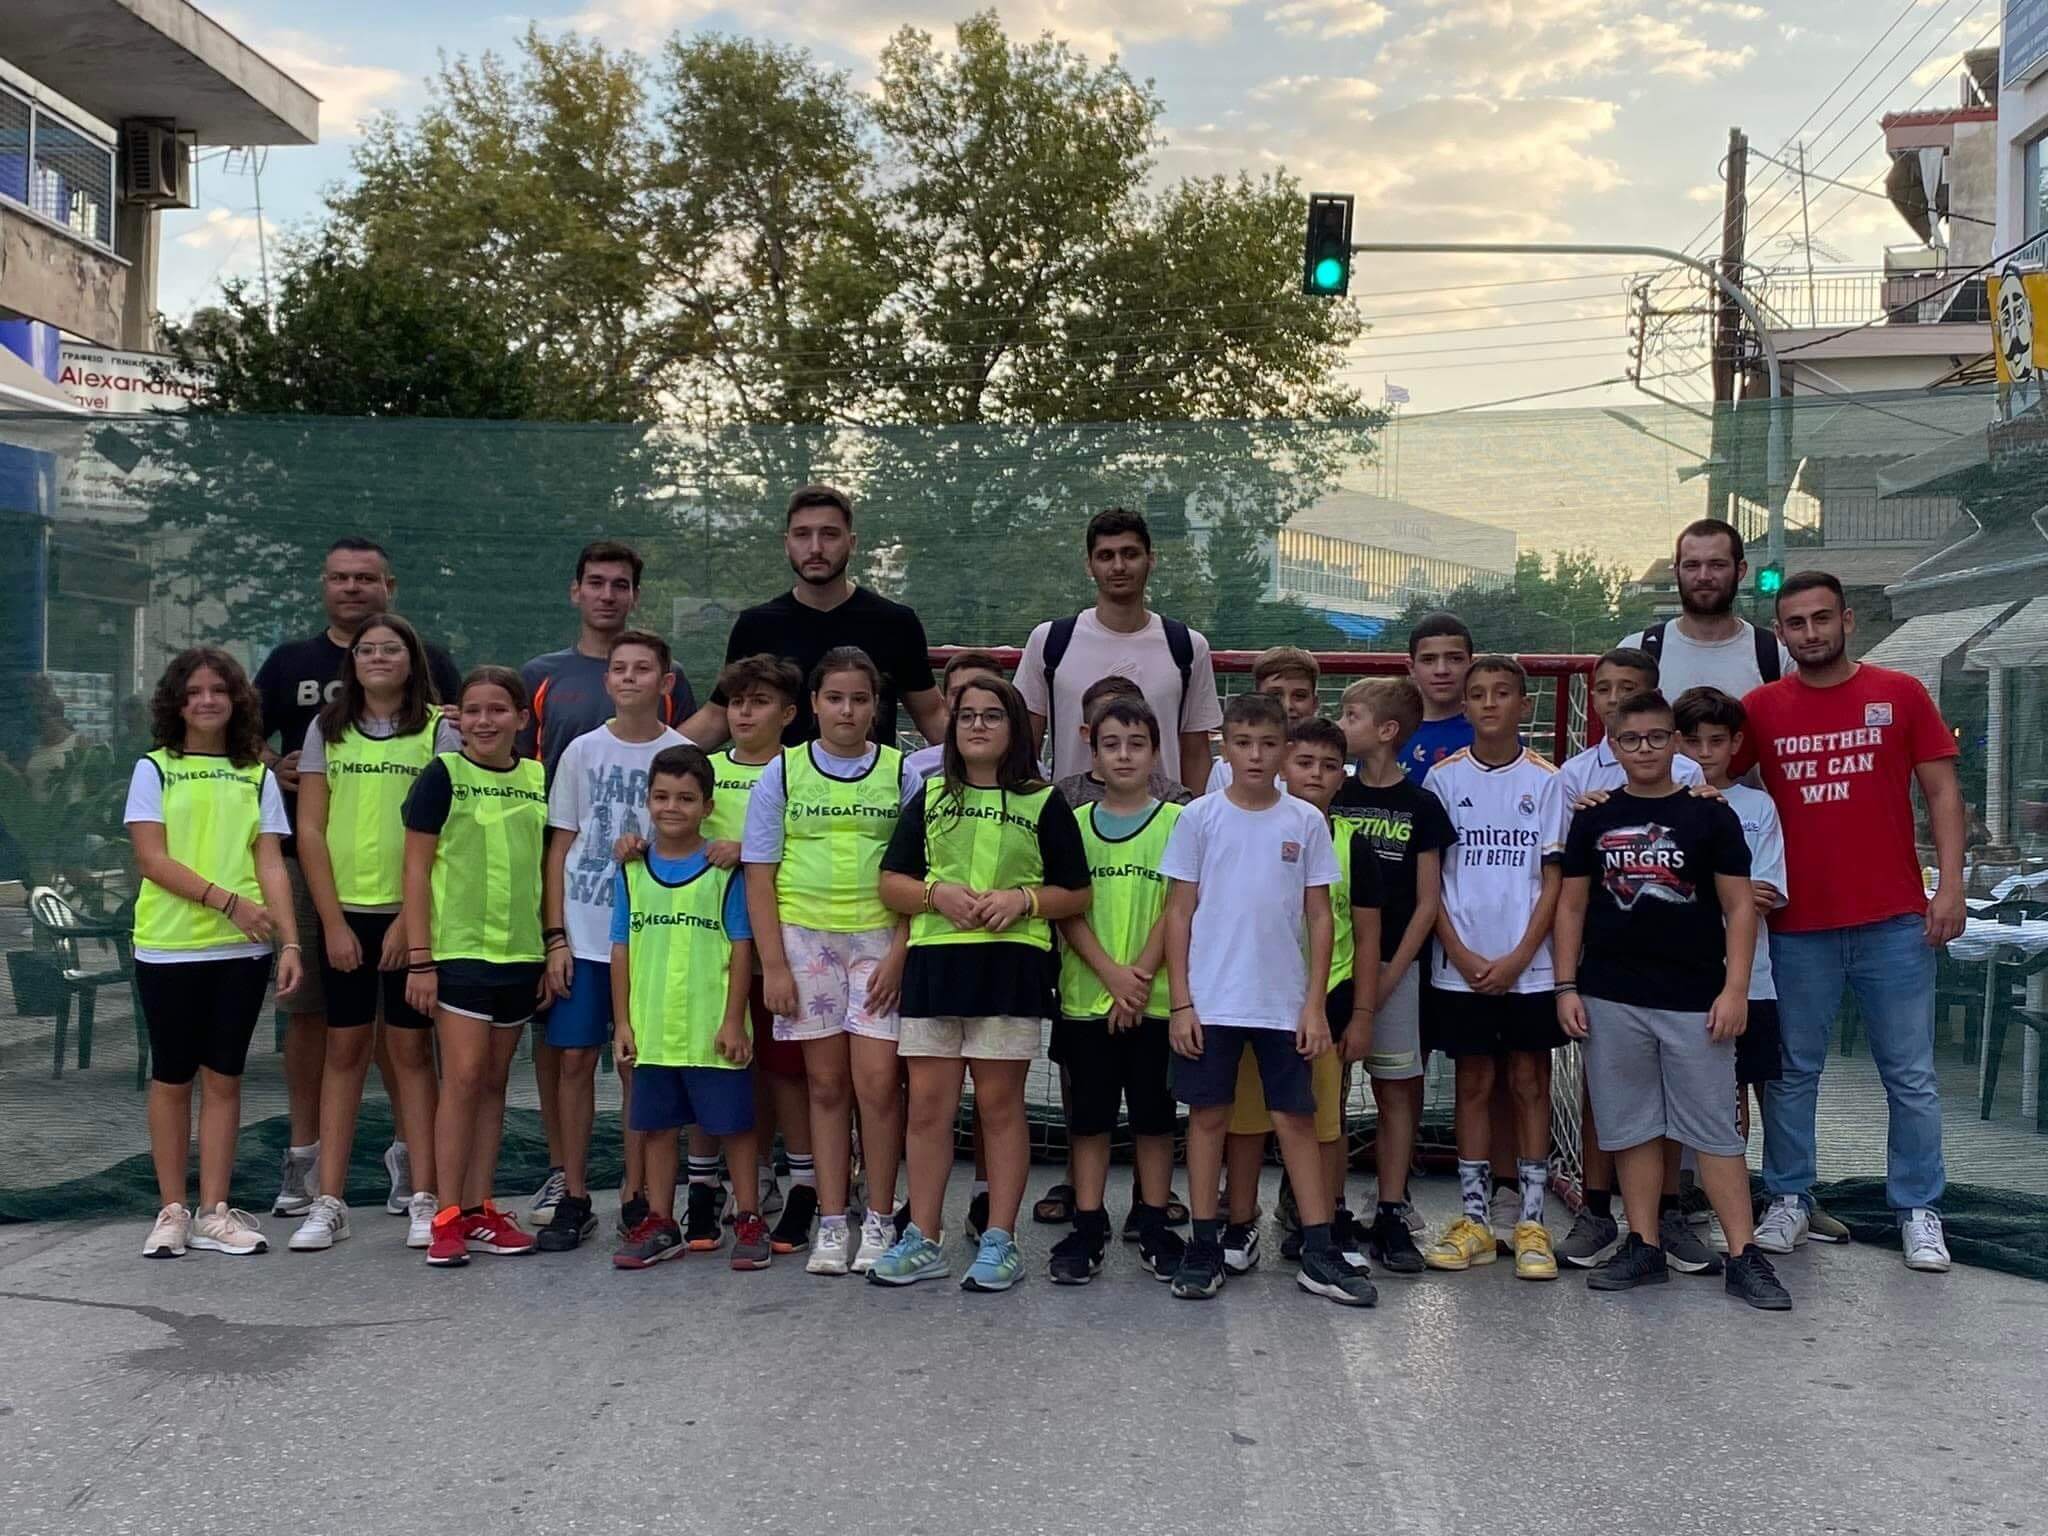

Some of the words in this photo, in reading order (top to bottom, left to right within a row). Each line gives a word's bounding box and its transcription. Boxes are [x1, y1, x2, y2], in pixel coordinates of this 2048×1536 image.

[1774, 727, 1883, 757] TOGETHER
[1781, 760, 1818, 780] WE
[1828, 752, 1875, 776] CAN
[1800, 781, 1850, 804] WIN
[1457, 825, 1540, 847] Emirates
[1465, 849, 1483, 867] FLY
[1486, 849, 1526, 867] BETTER
[1605, 850, 1685, 869] NRGRS
